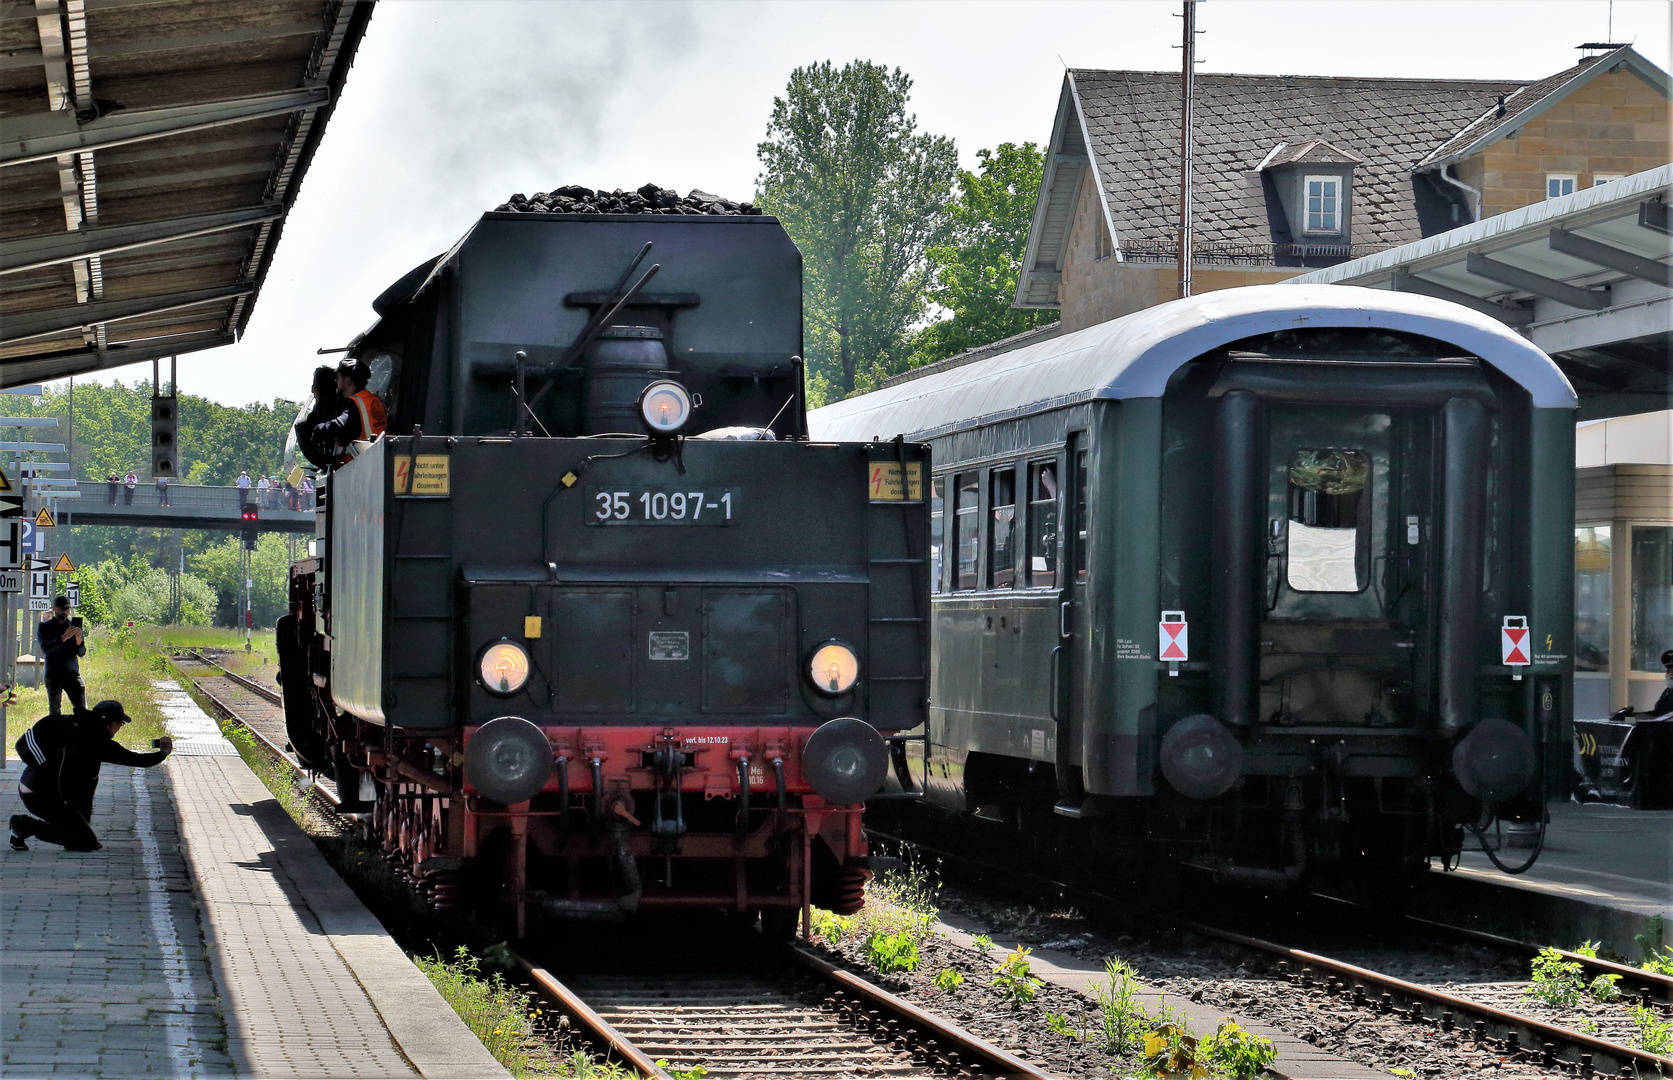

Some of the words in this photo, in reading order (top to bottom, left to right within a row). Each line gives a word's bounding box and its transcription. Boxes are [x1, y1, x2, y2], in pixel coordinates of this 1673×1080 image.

[595, 492, 630, 520] 35
[639, 492, 731, 520] 1097-1
[32, 573, 48, 596] H
[31, 600, 48, 609] 110m
[697, 736, 706, 744] bis
[707, 736, 728, 744] 12.10.23
[751, 766, 763, 775] Mei
